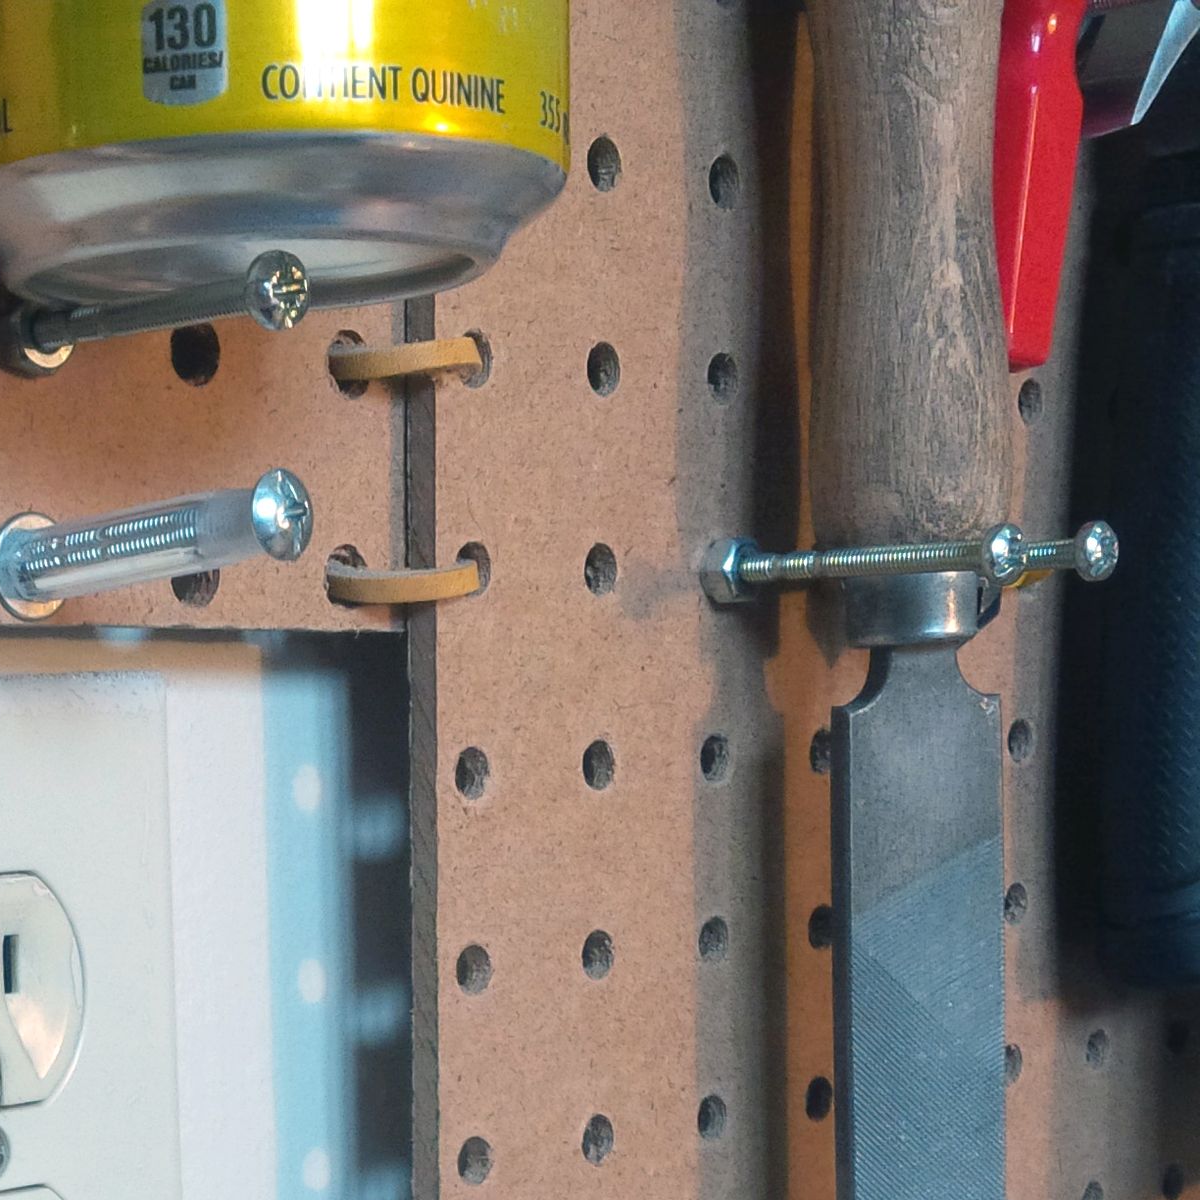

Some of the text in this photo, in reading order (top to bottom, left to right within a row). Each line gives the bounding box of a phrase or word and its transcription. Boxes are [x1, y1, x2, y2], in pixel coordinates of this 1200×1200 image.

[149, 2, 218, 51] 130
[411, 67, 506, 115] QUININE
[541, 91, 561, 133] 355
